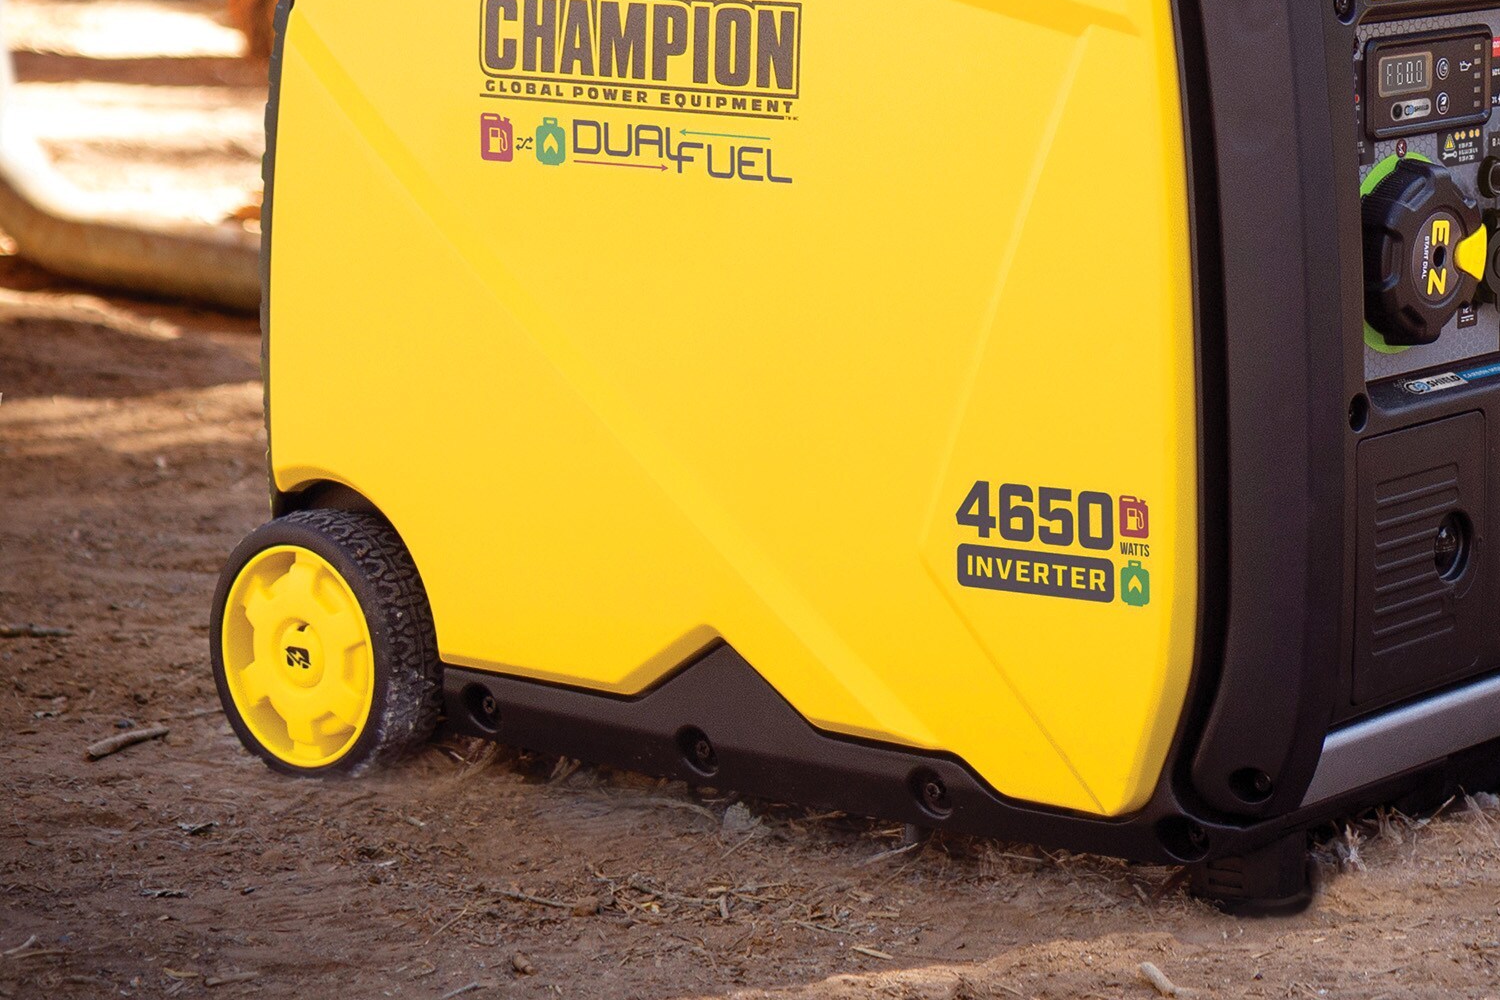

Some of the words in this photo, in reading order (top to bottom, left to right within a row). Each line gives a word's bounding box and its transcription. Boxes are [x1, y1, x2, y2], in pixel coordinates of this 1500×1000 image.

[485, 79, 564, 97] GLOBAL
[573, 85, 648, 103] POWER
[660, 92, 793, 113] EQUIPMENT
[956, 480, 1113, 550] 4650
[1120, 542, 1150, 557] WATTS
[967, 555, 1106, 592] INVERTER
